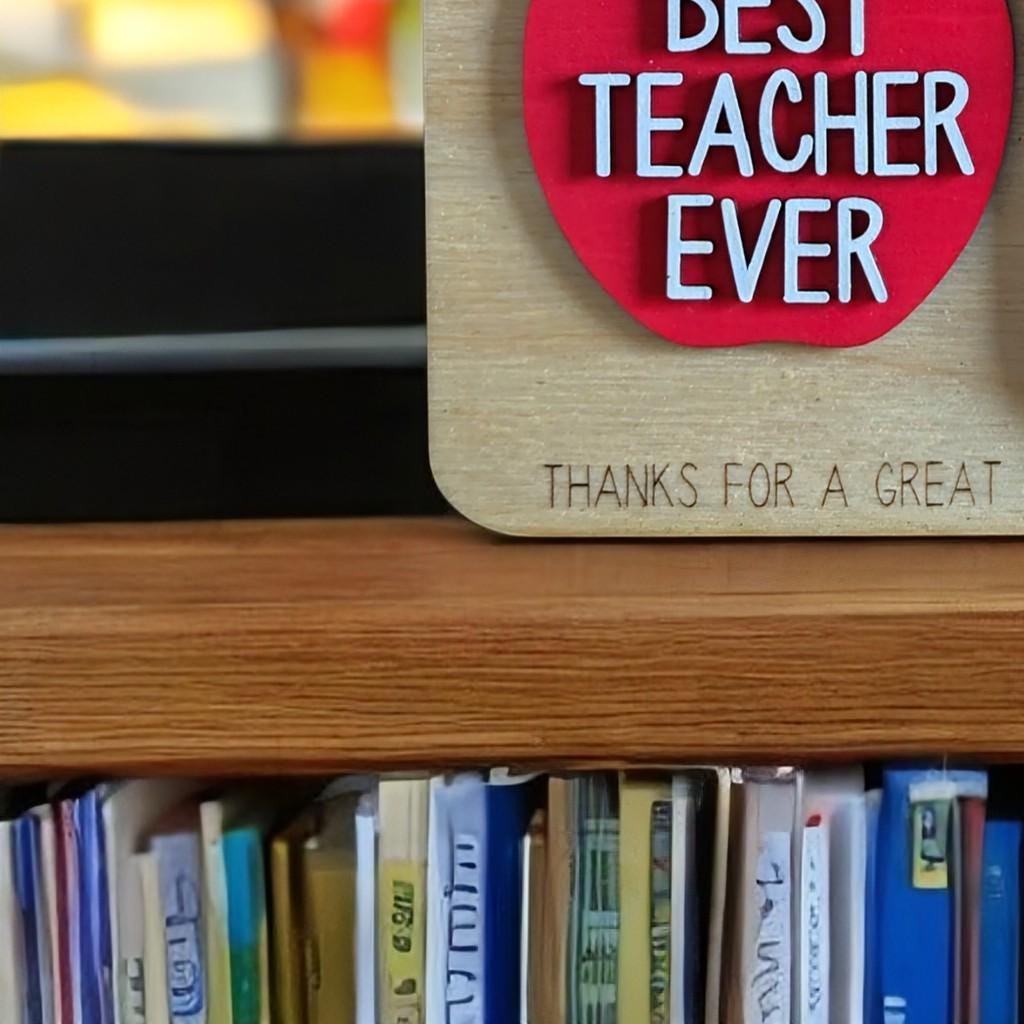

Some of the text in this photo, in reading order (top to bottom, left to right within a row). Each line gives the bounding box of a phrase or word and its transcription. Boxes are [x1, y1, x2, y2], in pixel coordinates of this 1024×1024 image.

[578, 68, 976, 177] TEACHER
[666, 194, 888, 303] EVER
[543, 462, 698, 509] THANKS
[723, 461, 795, 508] FOR
[820, 462, 849, 508] A
[874, 460, 1002, 508] GREAT
